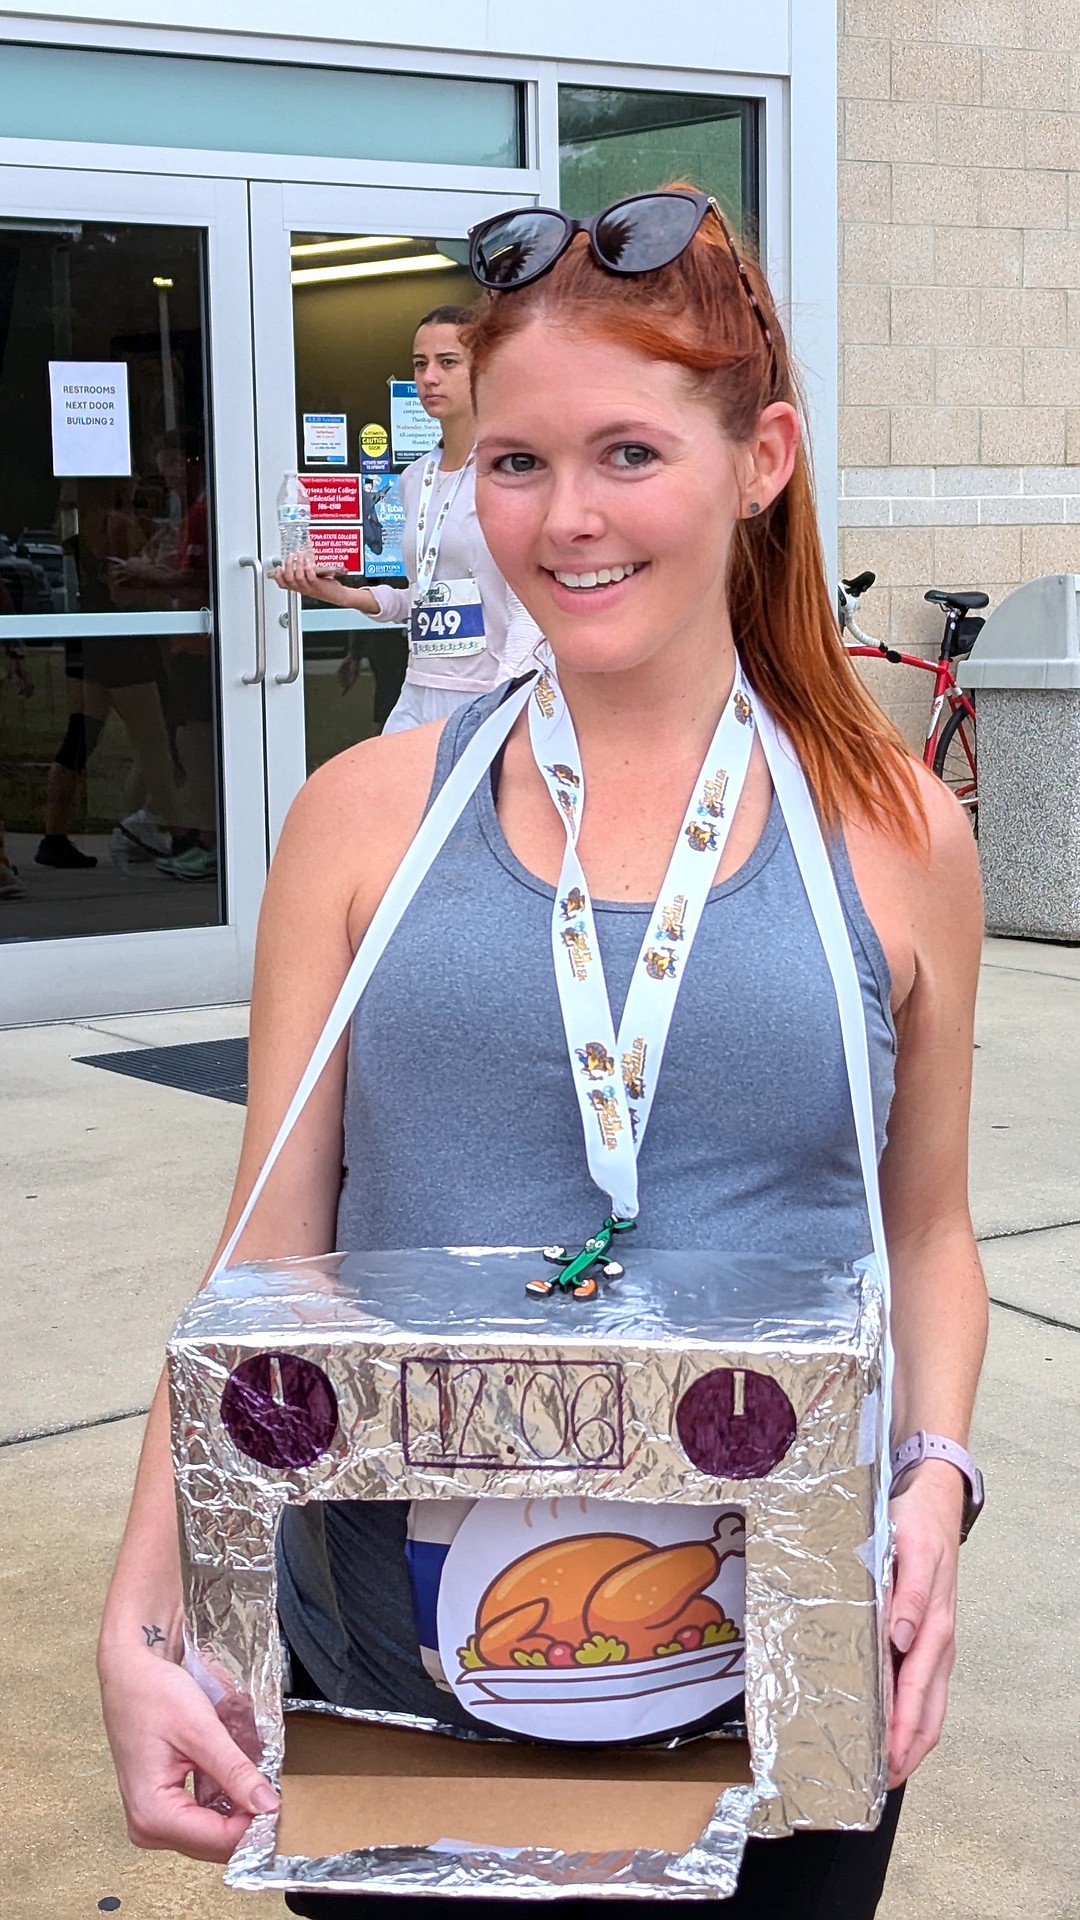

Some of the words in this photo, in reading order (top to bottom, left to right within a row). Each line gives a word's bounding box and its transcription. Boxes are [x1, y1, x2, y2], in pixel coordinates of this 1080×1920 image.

[63, 385, 116, 395] RESTROOMS
[65, 401, 87, 410] NEXT
[89, 401, 115, 410] DOOR
[66, 416, 108, 426] BUILDING
[109, 417, 115, 426] 2
[338, 487, 357, 495] College
[336, 494, 356, 502] Hotline
[380, 504, 386, 513] A
[387, 504, 404, 513] Toba
[380, 512, 406, 521] Campu
[417, 609, 462, 637] 949
[426, 1366, 617, 1461] 12:06
